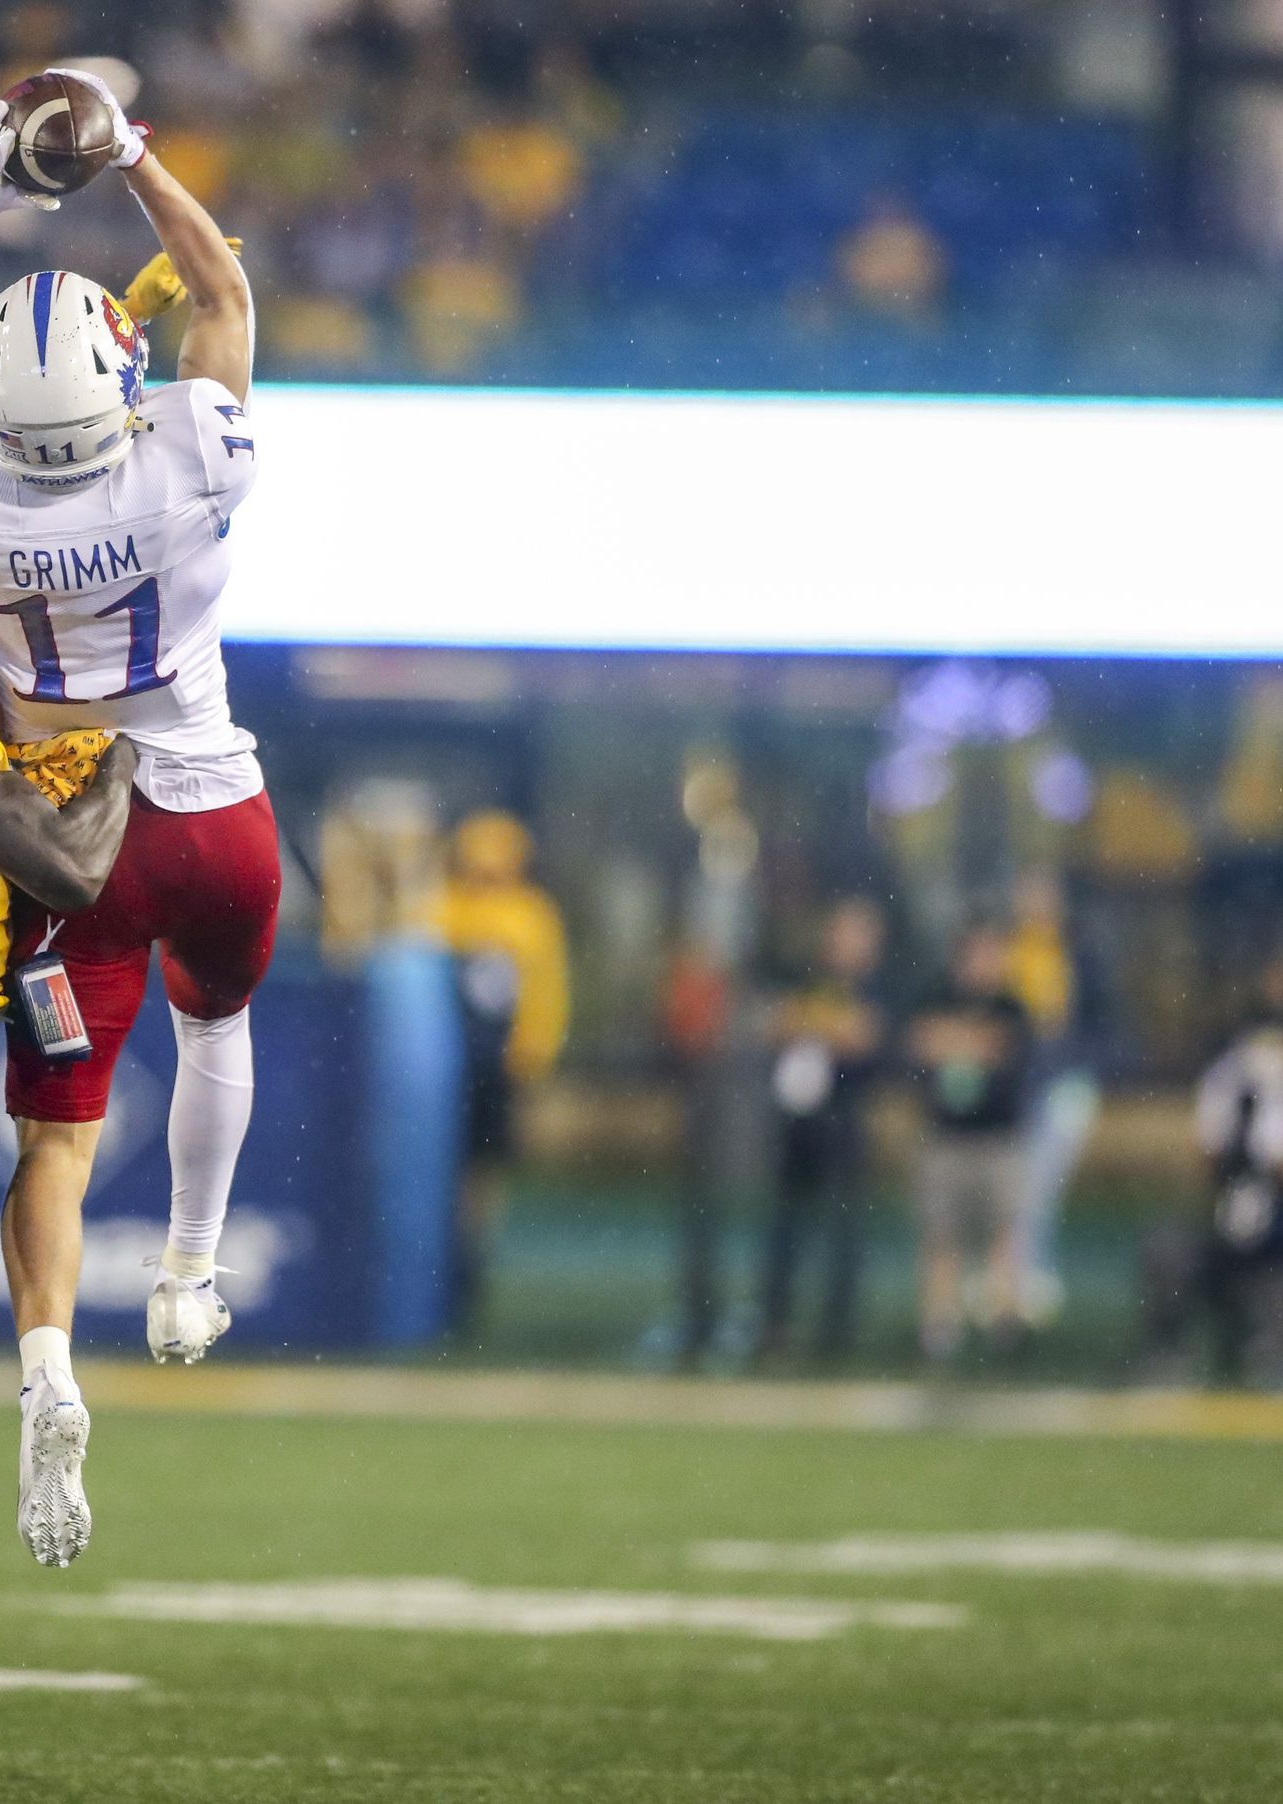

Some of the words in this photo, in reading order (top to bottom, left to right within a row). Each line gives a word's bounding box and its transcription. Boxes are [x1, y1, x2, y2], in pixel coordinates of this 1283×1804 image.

[34, 441, 77, 464] 11
[20, 465, 110, 486] JAYHAWKS
[10, 535, 142, 590] GRIMM
